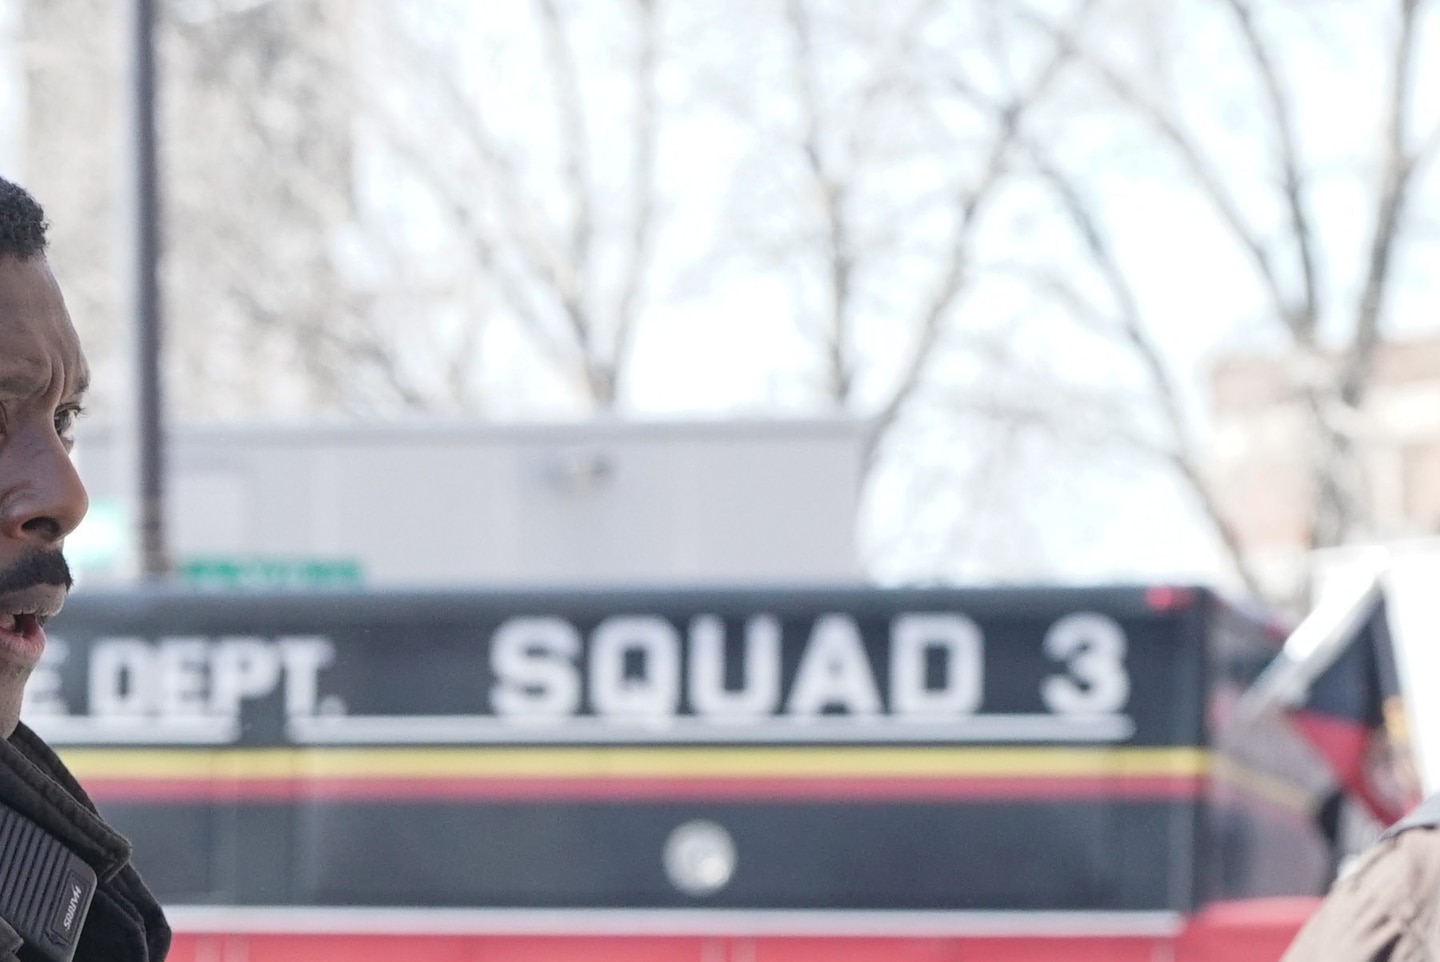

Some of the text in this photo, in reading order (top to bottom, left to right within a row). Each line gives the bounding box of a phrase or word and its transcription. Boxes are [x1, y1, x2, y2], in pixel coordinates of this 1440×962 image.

[87, 634, 348, 720] DEPT.
[489, 613, 984, 726] SQUAD
[1041, 612, 1131, 720] 3
[63, 883, 82, 931] HARRIS
